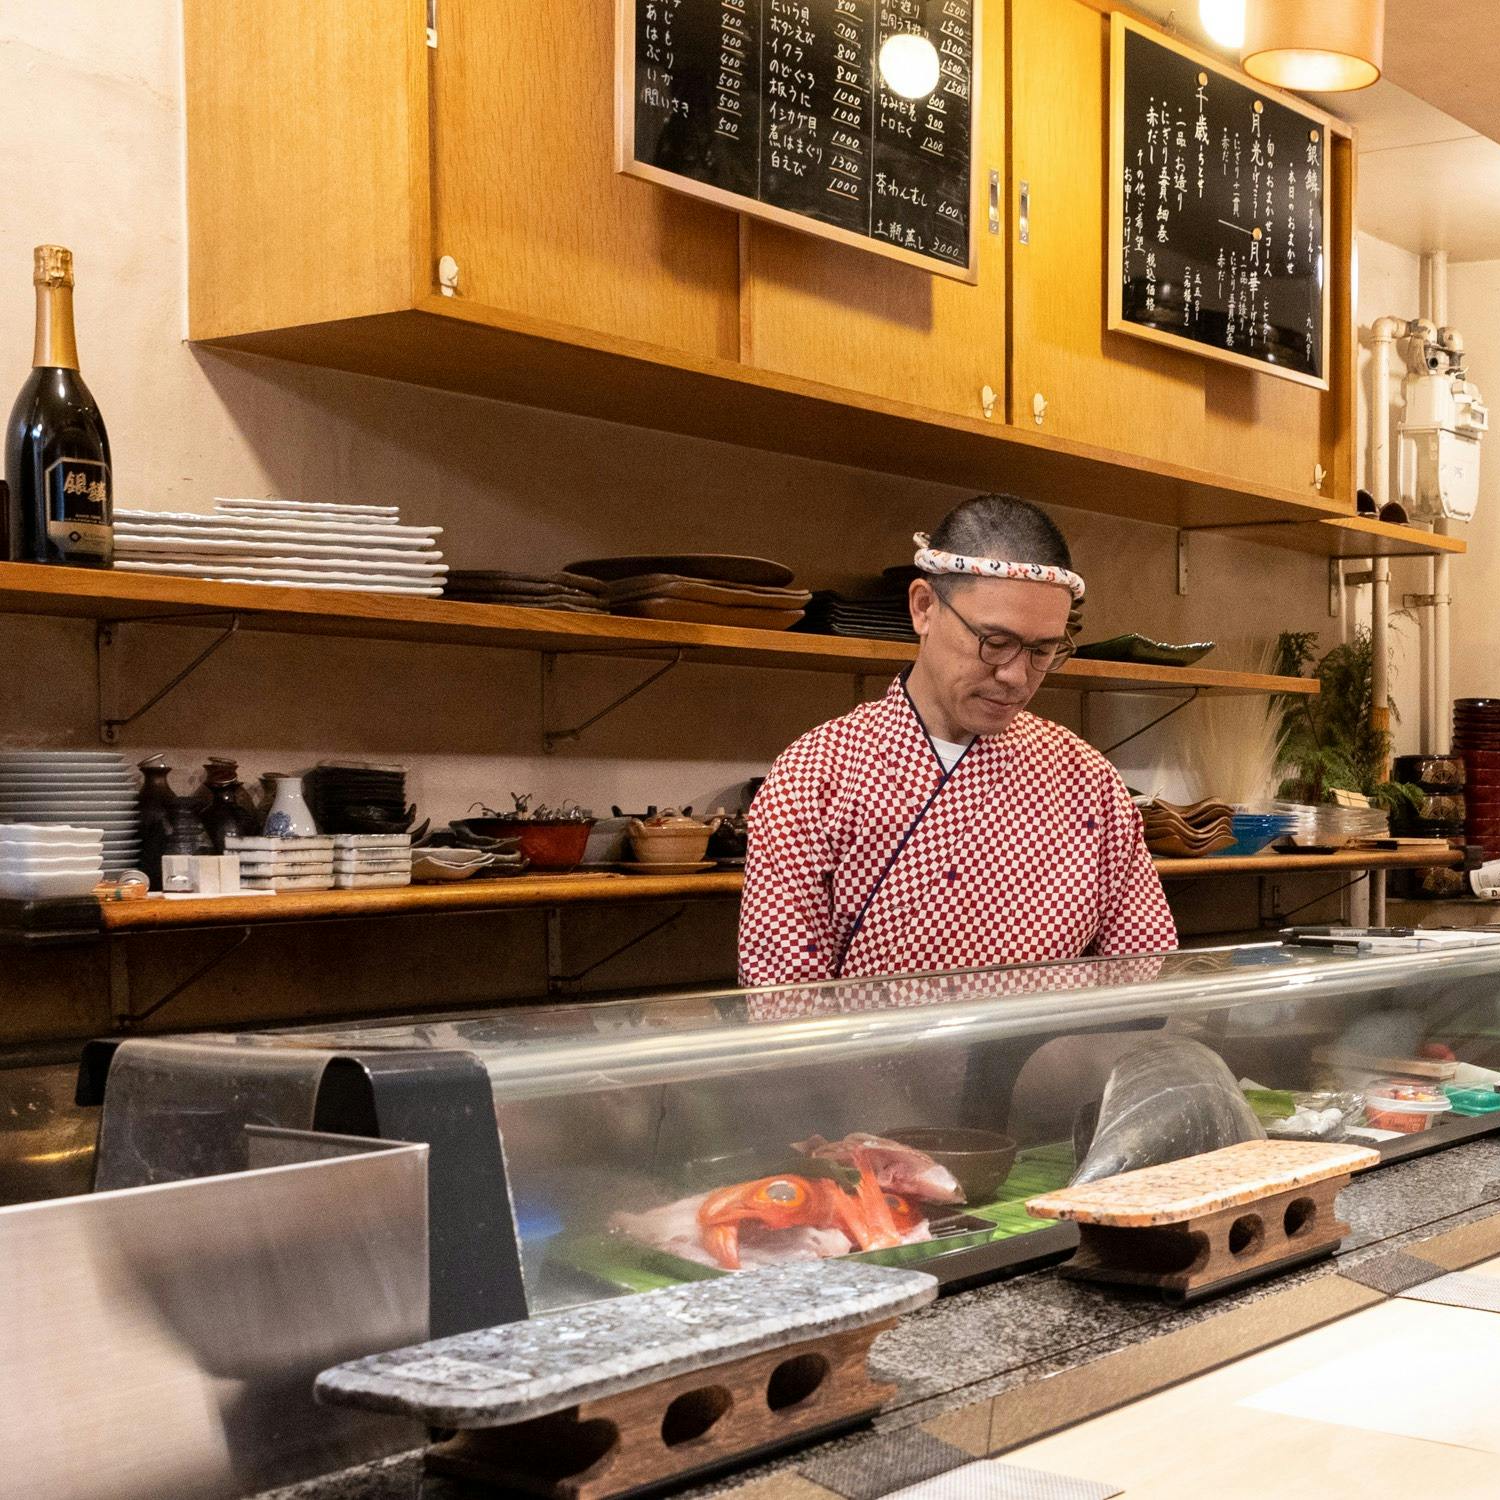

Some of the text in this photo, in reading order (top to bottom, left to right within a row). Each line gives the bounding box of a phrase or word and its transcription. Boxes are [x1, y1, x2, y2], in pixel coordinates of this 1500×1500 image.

[646, 3, 742, 27] あじ 400
[943, 1, 966, 17] 1500
[646, 25, 742, 48] はも 400
[770, 15, 856, 61] ボタンえび 800
[941, 20, 964, 37] 1500
[646, 44, 740, 69] ぶり 400
[941, 39, 963, 55] 1900
[771, 38, 803, 62] イクラ
[837, 65, 857, 83] 800
[941, 59, 962, 75] 1500
[647, 68, 740, 89] いか 500
[769, 59, 860, 106] のどぐろ 1000
[944, 80, 967, 96] 1500
[718, 94, 740, 110] 500
[769, 78, 860, 125] 板うに 1000
[928, 94, 945, 109] 600
[718, 117, 738, 133] 500
[927, 114, 944, 129] 900
[832, 131, 860, 149] 1000
[880, 113, 944, 152] トロたく 1200
[771, 150, 858, 194] 白えび 1000
[831, 155, 859, 174] 1300
[875, 172, 959, 218] 茶わんむし 600
[932, 236, 959, 257] 3000
